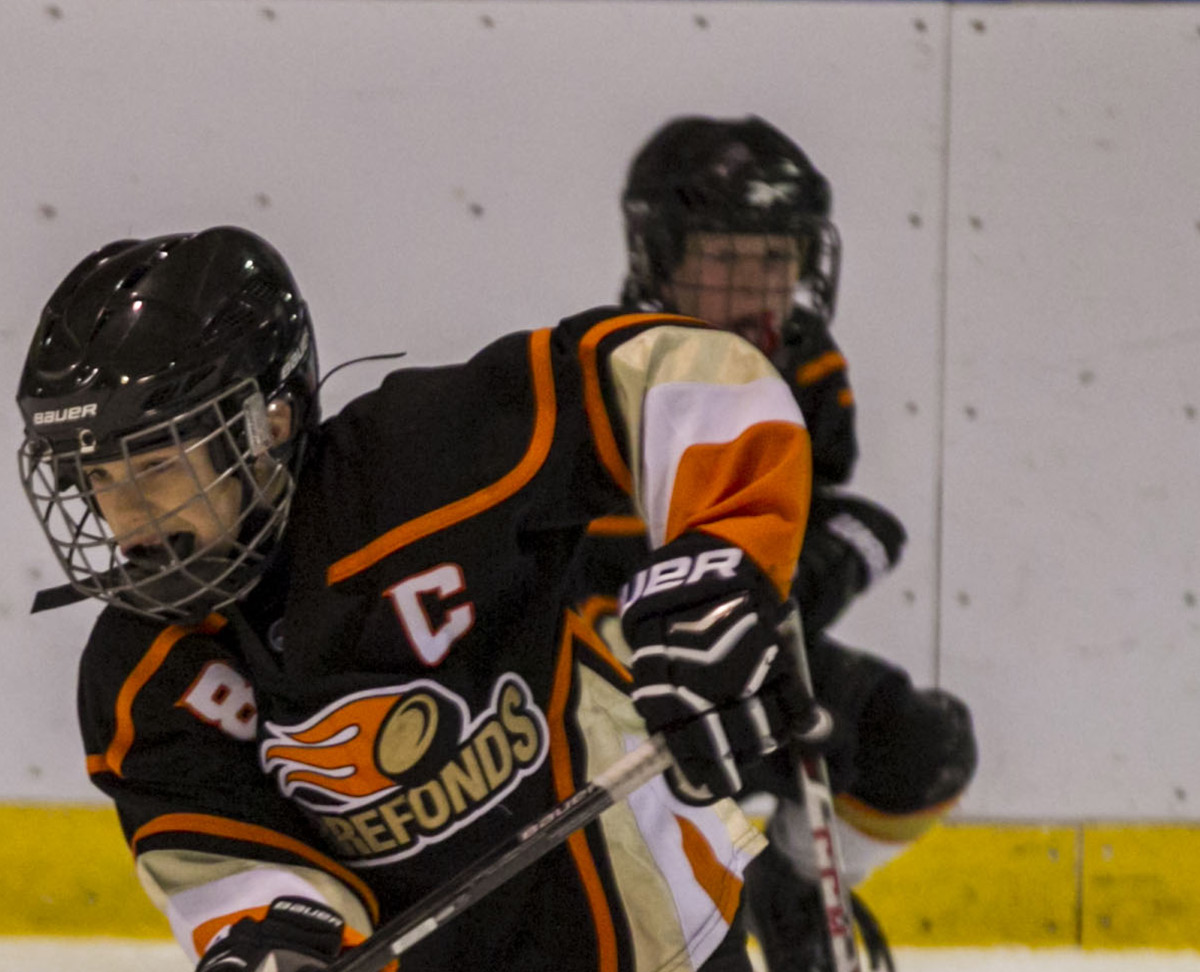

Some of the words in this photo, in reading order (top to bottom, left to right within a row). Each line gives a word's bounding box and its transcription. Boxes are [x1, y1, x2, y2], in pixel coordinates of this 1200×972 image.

[33, 403, 98, 425] BAUER
[382, 562, 475, 667] C
[618, 547, 744, 619] UER
